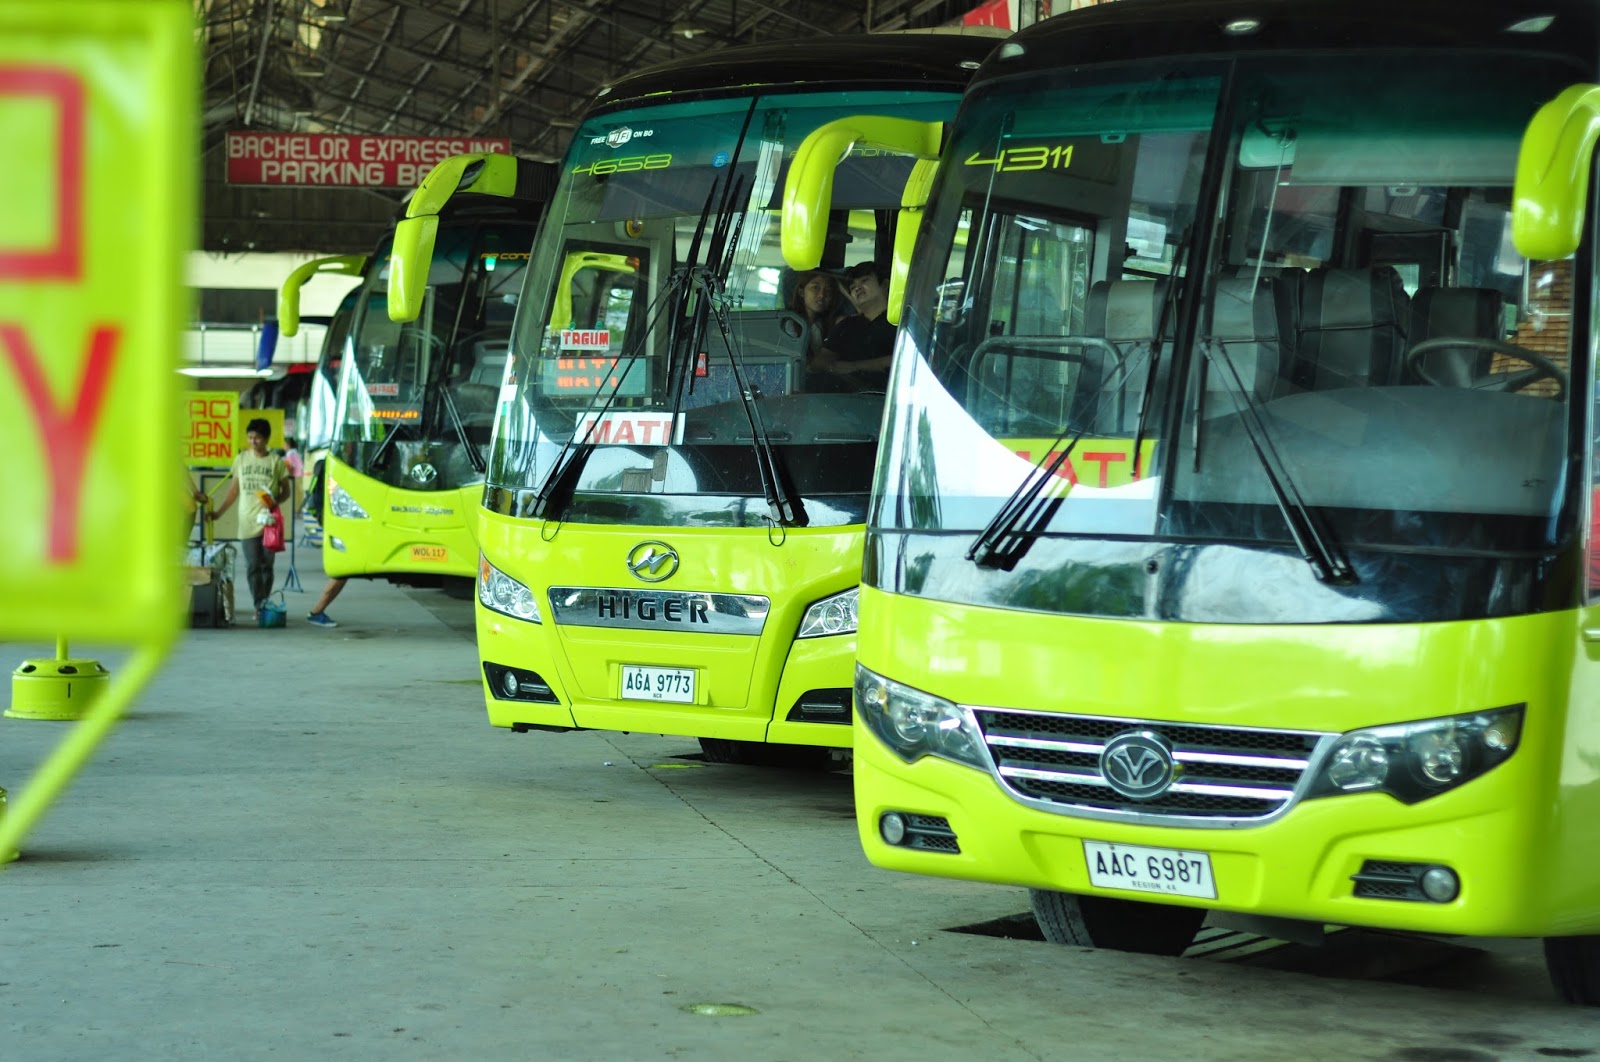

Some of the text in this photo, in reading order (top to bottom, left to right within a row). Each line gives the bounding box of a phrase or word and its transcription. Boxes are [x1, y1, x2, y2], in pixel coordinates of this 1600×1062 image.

[229, 136, 350, 160] BACHELOR
[360, 138, 465, 163] EXPRESS
[590, 137, 606, 145] FREE
[572, 153, 673, 176] 4658
[964, 145, 1074, 173] 4311
[261, 161, 434, 186] PARKING BA
[562, 331, 609, 345] TAGUM
[585, 420, 671, 445] MATI
[413, 547, 446, 558] WOL 117
[598, 595, 710, 624] HIGER
[626, 671, 690, 694] AGA 9773
[1097, 850, 1202, 884] AAC 6987
[1132, 880, 1160, 889] REGION
